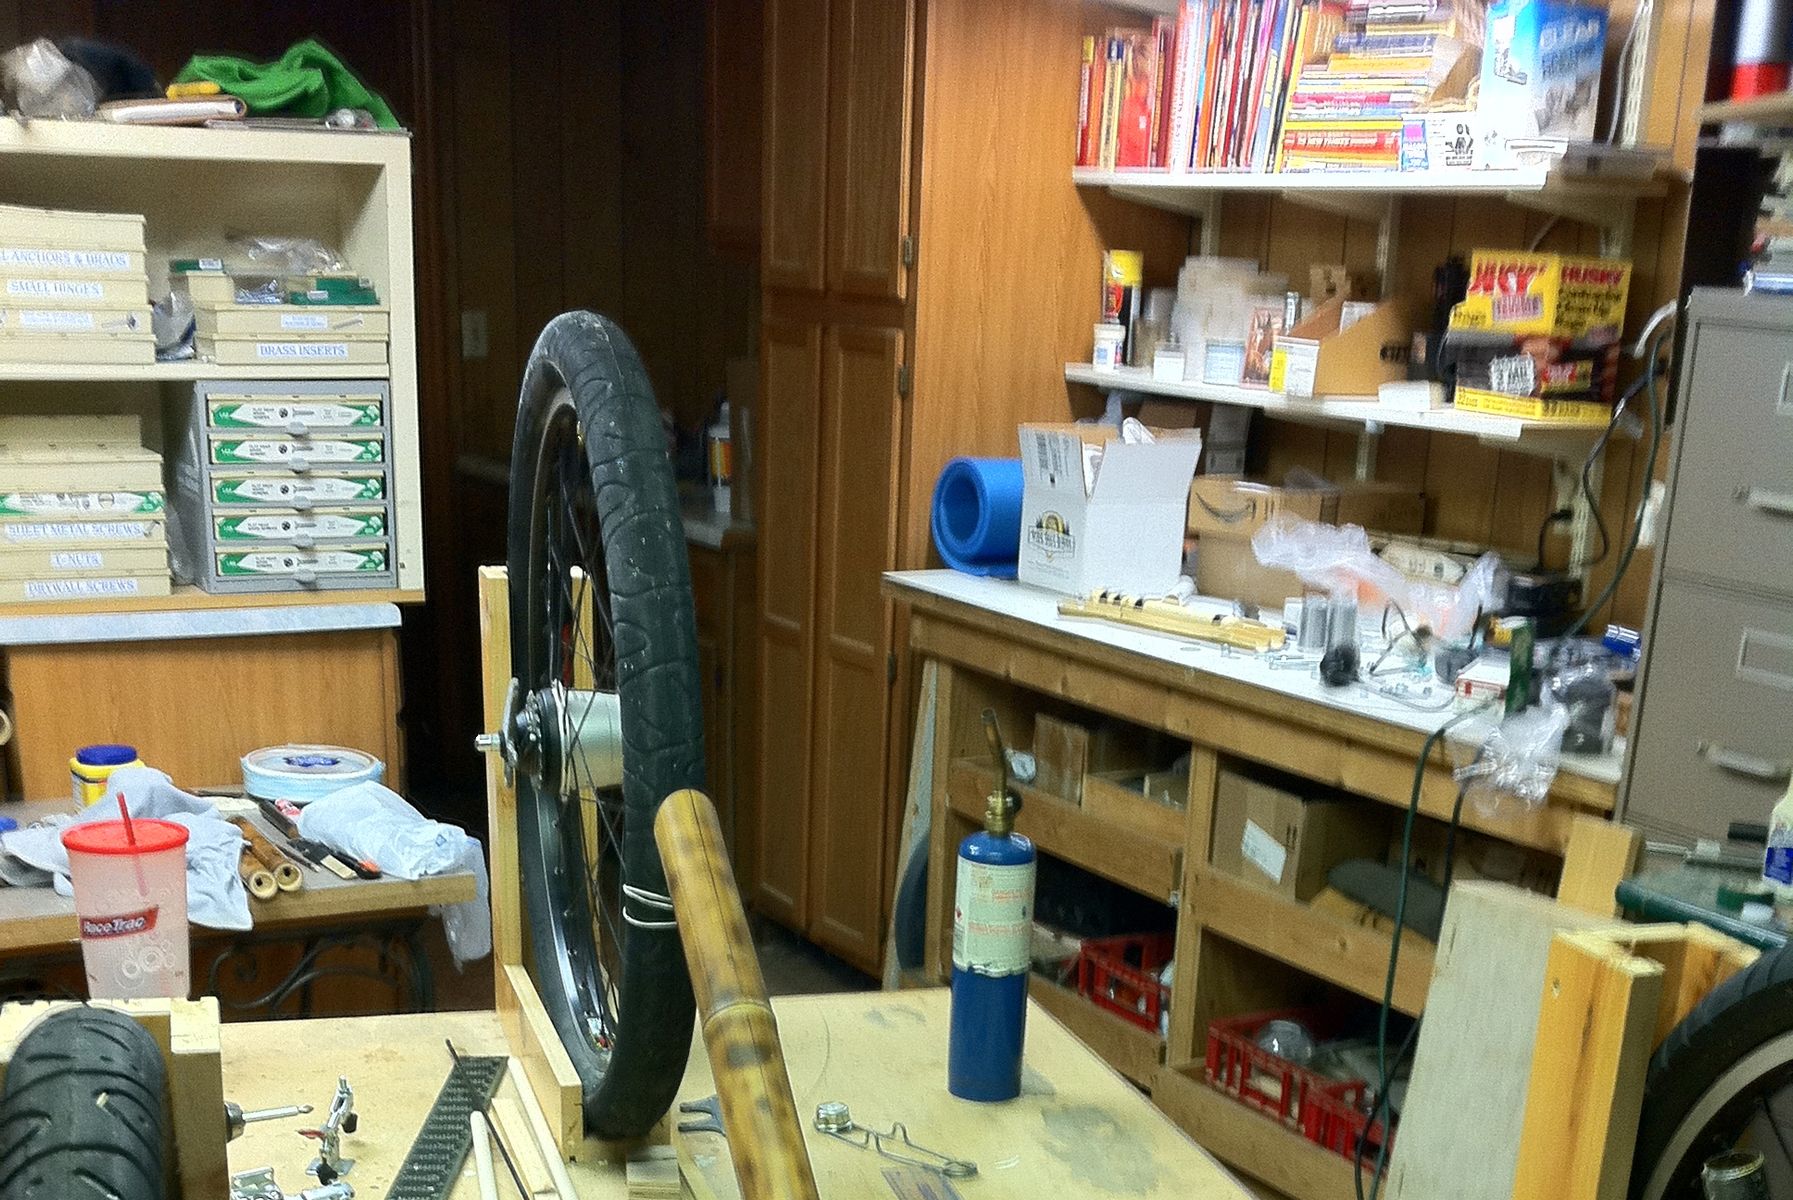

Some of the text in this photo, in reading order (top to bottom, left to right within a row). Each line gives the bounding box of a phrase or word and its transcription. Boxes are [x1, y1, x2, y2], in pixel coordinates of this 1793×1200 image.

[11, 281, 100, 294] SMALL HINGES
[260, 344, 345, 356] BRASS INSERTS
[8, 524, 141, 537] SHEET METAL SCREWS
[28, 580, 135, 596] DRYWALL SCREWS
